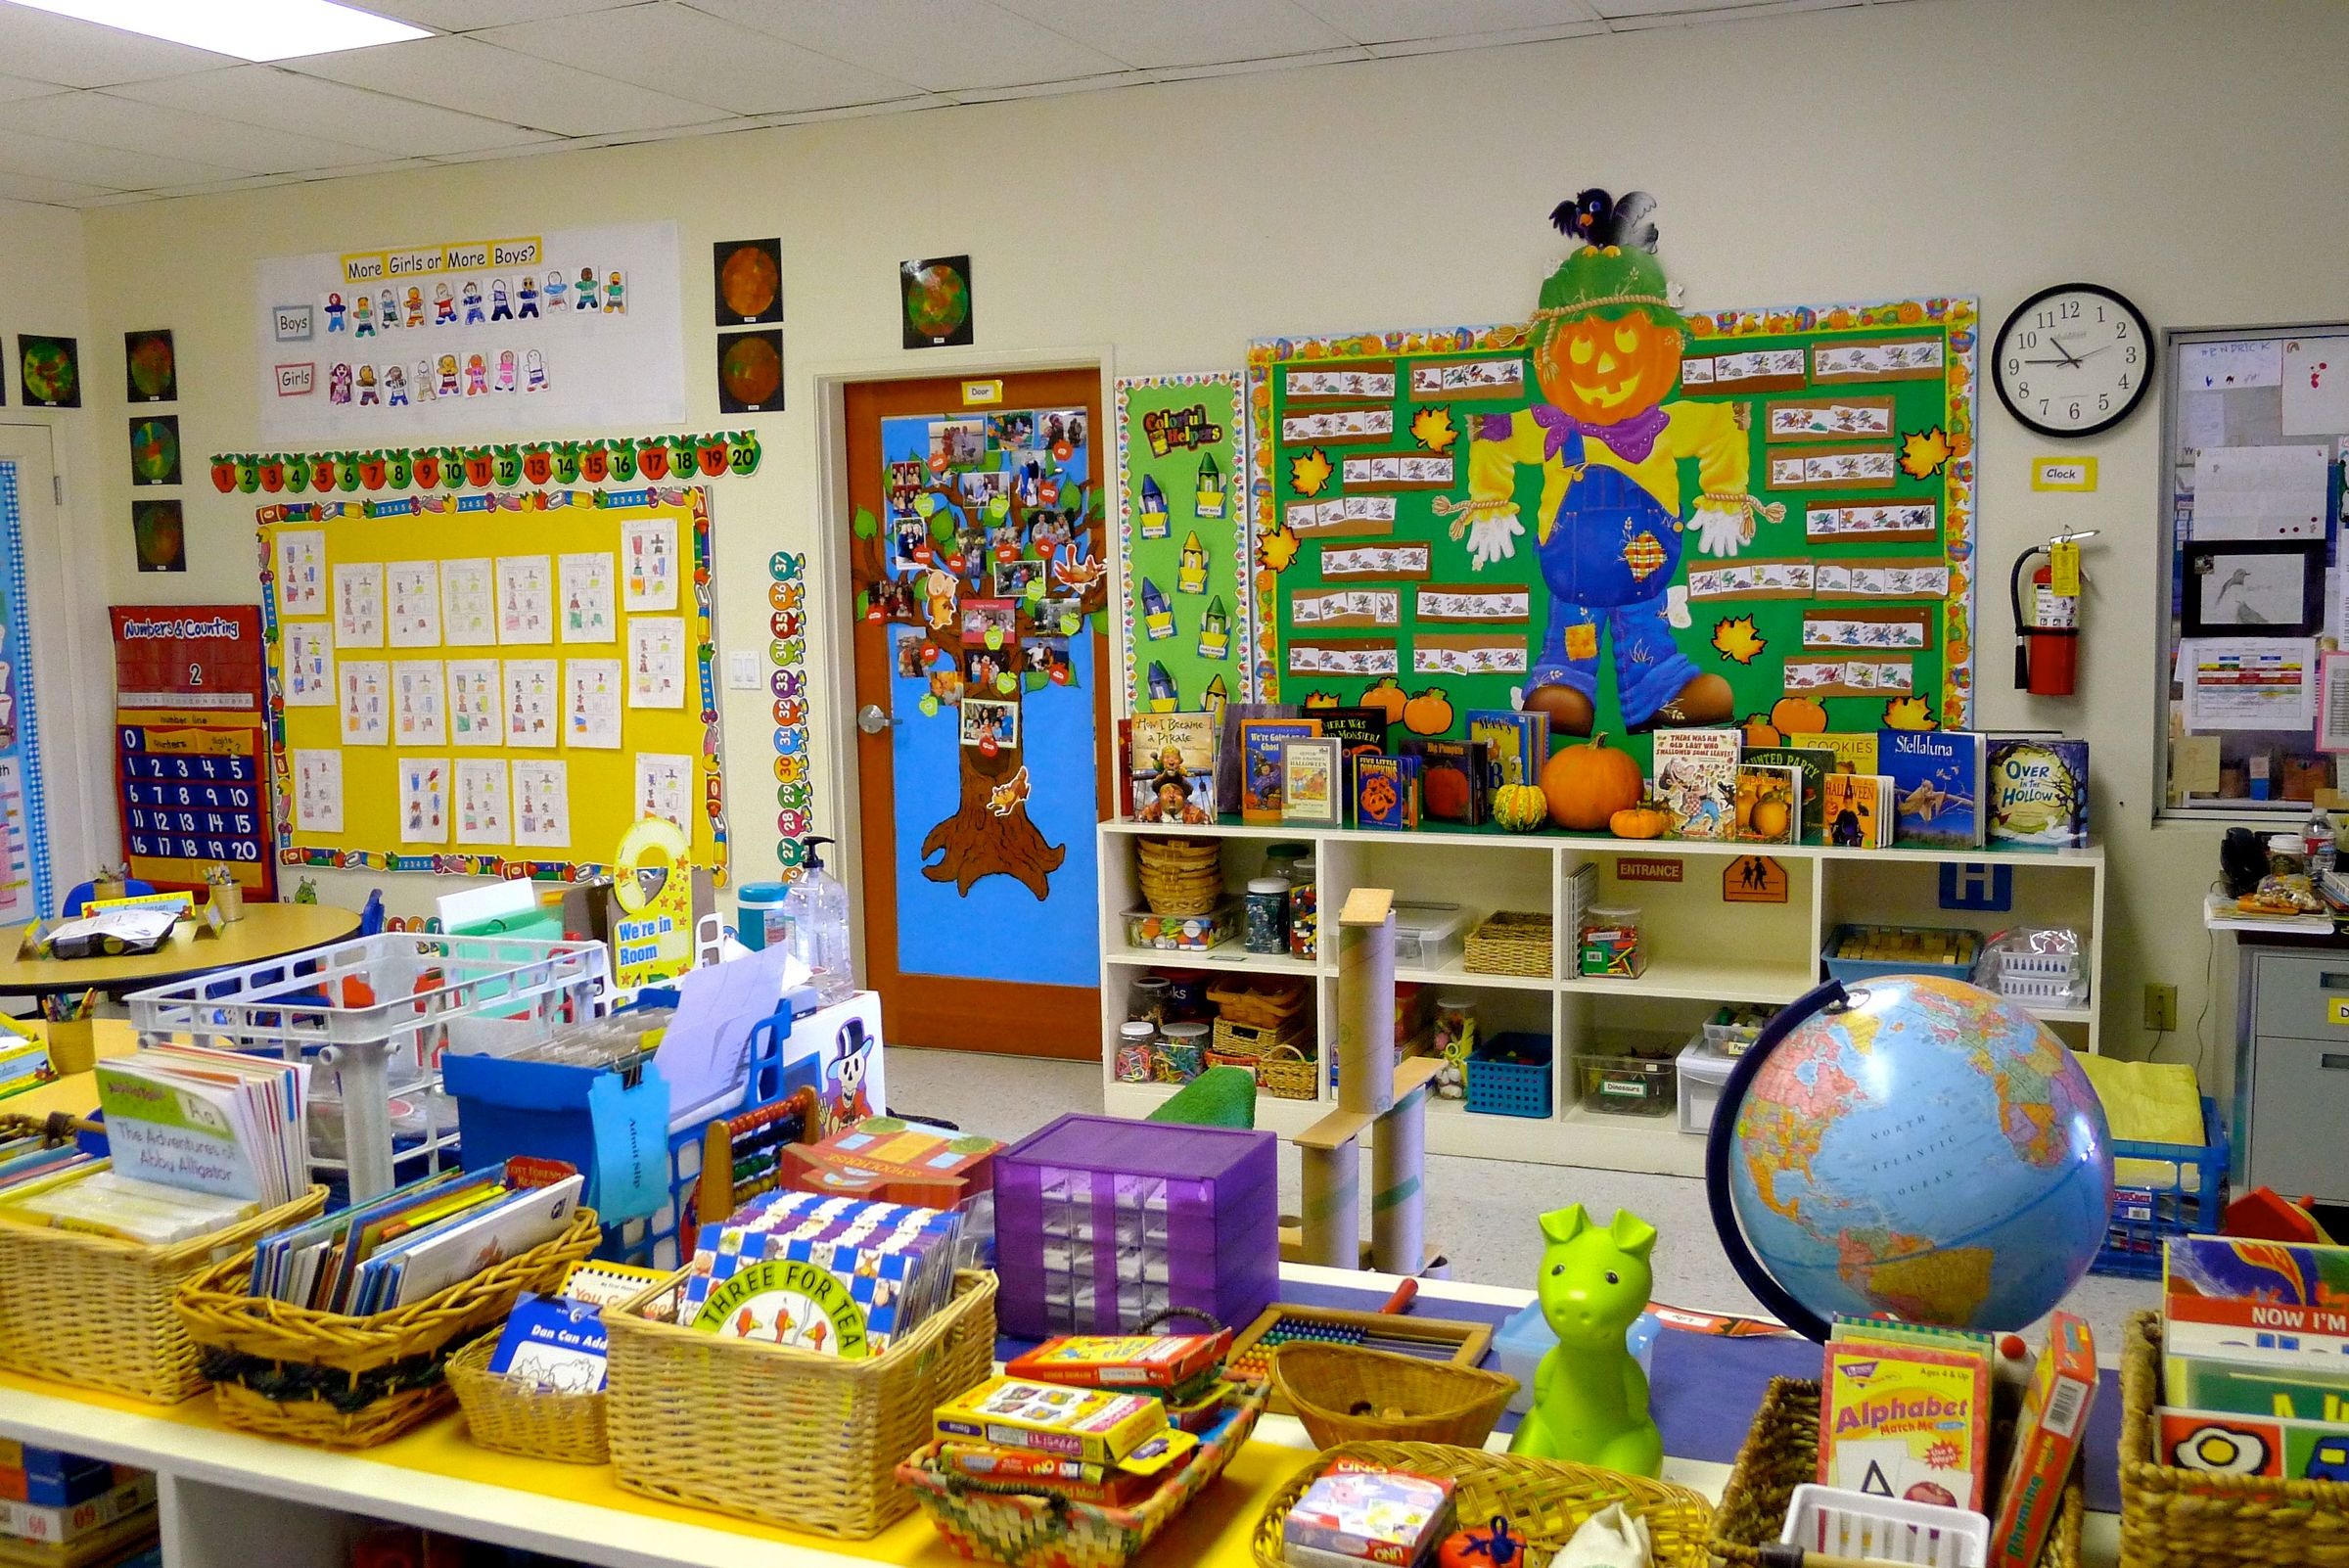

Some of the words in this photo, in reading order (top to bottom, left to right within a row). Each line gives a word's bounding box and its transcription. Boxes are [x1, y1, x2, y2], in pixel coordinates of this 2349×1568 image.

[348, 262, 383, 279] More
[390, 255, 423, 274] Girls
[427, 256, 442, 269] or
[447, 252, 485, 268] More
[494, 245, 536, 264] Boys?
[2060, 301, 2080, 319] 12
[2096, 306, 2105, 322] 1
[280, 314, 307, 332] Boys
[2037, 311, 2055, 329] 11
[2117, 322, 2127, 339] 2
[2018, 332, 2037, 349] 10
[2126, 346, 2137, 363] 3
[2008, 359, 2019, 375] 9
[282, 369, 310, 386] Girls
[2118, 373, 2130, 389] 4
[972, 388, 989, 396] Door
[2019, 382, 2030, 398] 8
[2040, 399, 2050, 415] 7
[2098, 393, 2109, 410] 5
[1145, 408, 1203, 430] Colorful
[2069, 403, 2080, 419] 6
[1168, 426, 1220, 447] Helpers
[221, 470, 228, 485] 1
[245, 471, 253, 484] 2
[268, 471, 277, 485] 3
[291, 470, 300, 485] 4
[319, 468, 328, 484] 5
[345, 468, 353, 484] 6
[369, 467, 378, 483] 7
[394, 466, 403, 482] 8
[422, 465, 431, 480] 9
[445, 464, 462, 480] 10
[474, 463, 486, 478] 11
[498, 461, 514, 478] 12
[530, 459, 546, 476] 13
[557, 458, 575, 475] 14
[587, 457, 602, 474] 15
[614, 456, 630, 473] 16
[647, 454, 662, 471] 17
[675, 452, 693, 469] 18
[705, 450, 722, 467] 19
[732, 448, 755, 467] 20
[2047, 469, 2076, 479] Clock
[775, 556, 787, 573] 37
[775, 585, 786, 602] 36
[125, 619, 173, 638] Numbers
[174, 620, 183, 638] &
[185, 618, 238, 638] Counting
[776, 613, 788, 632] 35
[775, 641, 787, 659] 34
[191, 665, 202, 684] 2
[776, 672, 788, 691] 33
[779, 701, 790, 718] 32
[1160, 718, 1166, 732] I
[1168, 718, 1205, 731] Became
[1323, 719, 1346, 730] HERE
[1348, 719, 1366, 729] WAS
[124, 729, 136, 748] 0
[780, 731, 791, 746] 31
[1251, 733, 1269, 742] We're
[1895, 734, 1954, 757] Stellaluna
[1808, 741, 1872, 754] COOKIES
[128, 757, 136, 775] 1
[152, 760, 162, 777] 2
[177, 760, 188, 777] 3
[203, 761, 214, 779] 4
[232, 760, 243, 779] 5
[780, 759, 791, 775] 30
[1376, 758, 1398, 766] LITTLE
[2006, 761, 2050, 780] OVER
[1359, 764, 1398, 782] PUMPKINS
[129, 785, 139, 803] 6
[154, 787, 163, 804] 7
[179, 788, 190, 805] 8
[207, 789, 217, 806] 9
[232, 789, 249, 807] 10
[783, 786, 794, 802] 29
[2003, 787, 2053, 807] HOLLOW
[134, 810, 144, 828] 11
[154, 812, 169, 831] 12
[179, 813, 194, 831] 13
[208, 814, 223, 832] 14
[235, 814, 251, 833] 15
[783, 813, 795, 830] 28
[133, 836, 147, 854] 16
[159, 838, 170, 856] 17
[182, 840, 198, 857] 18
[208, 841, 225, 859] 19
[232, 841, 257, 860] 20
[783, 842, 794, 857] 27
[1620, 863, 1680, 878] ENTRANCE
[1957, 863, 1994, 900] H
[619, 920, 655, 942] We're
[660, 916, 672, 932] in
[620, 944, 658, 966] Room
[1607, 1083, 1640, 1093] Dinosaurs
[1871, 1114, 1925, 1141] NORTH
[117, 1122, 143, 1142] The
[147, 1128, 219, 1156] Adventures
[628, 1119, 639, 1159] Admit
[1871, 1134, 1958, 1173] ATLANTIC
[140, 1149, 175, 1174] Abby
[179, 1157, 232, 1181] Alligator
[632, 1162, 641, 1189] Slip
[1898, 1170, 1954, 1195] OCEAN
[576, 1287, 602, 1305] You
[703, 1265, 774, 1325] THREE
[787, 1266, 832, 1301] FOR
[833, 1299, 861, 1348] TEA
[2252, 1307, 2304, 1328] NOW
[2313, 1312, 2346, 1332] I'M
[531, 1324, 554, 1339] Dan
[558, 1329, 579, 1344] Can
[582, 1335, 608, 1350] Add
[1920, 1367, 1940, 1378] Ages
[1942, 1368, 1948, 1377] 4
[1958, 1370, 1970, 1380] Up
[1835, 1395, 1967, 1434] Alphabet
[1880, 1421, 1915, 1436] Match
[1916, 1420, 1934, 1431] Me
[1337, 1459, 1388, 1474] UNO
[1861, 1458, 1895, 1498] A
[1373, 1545, 1405, 1562] UNO
